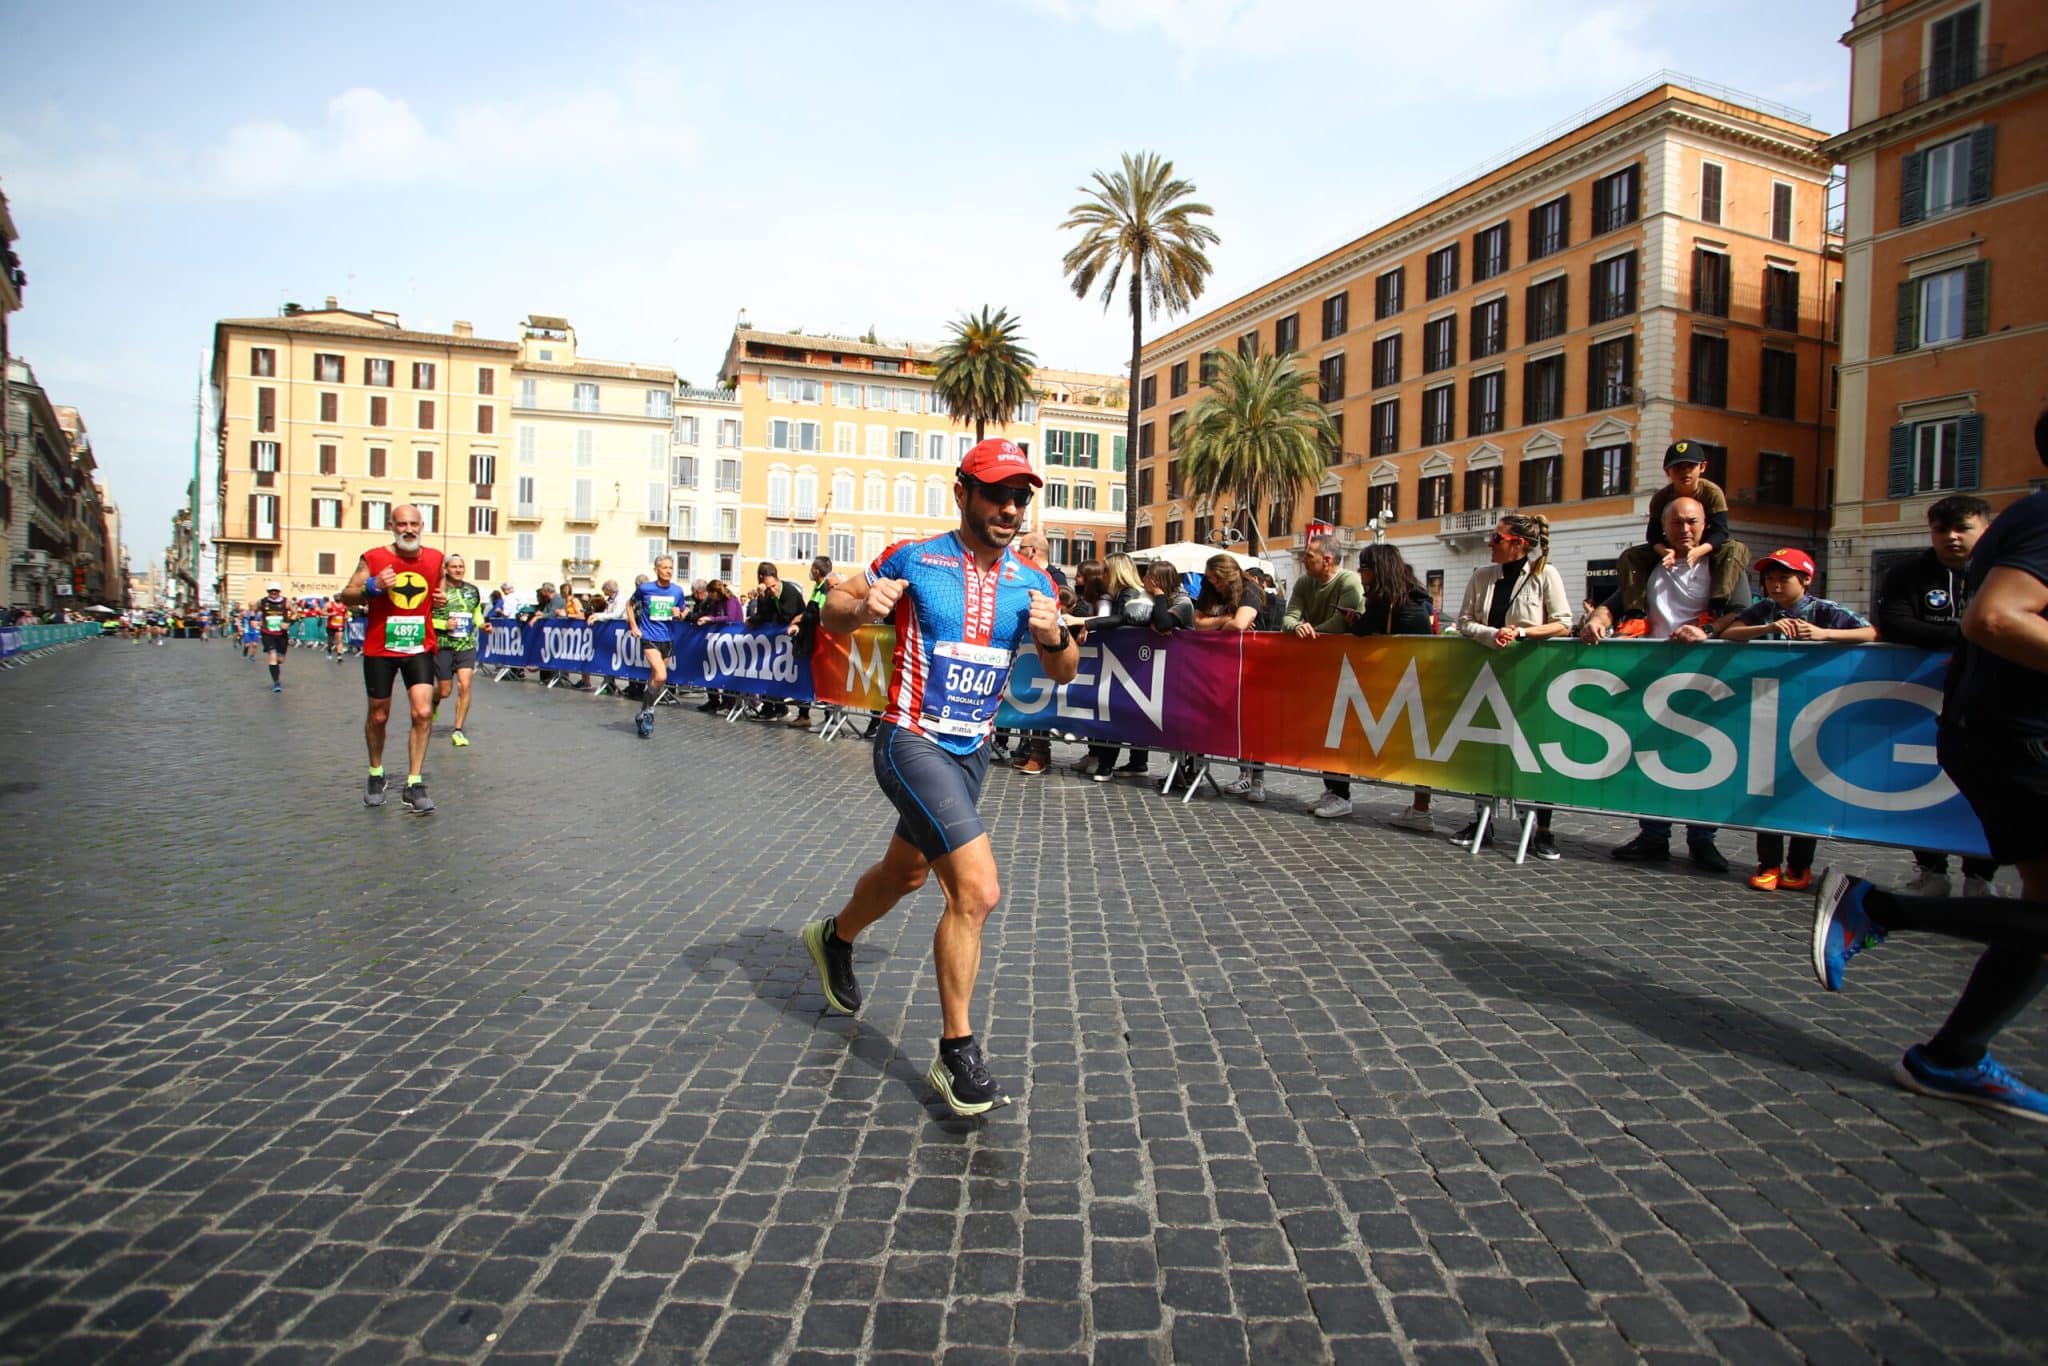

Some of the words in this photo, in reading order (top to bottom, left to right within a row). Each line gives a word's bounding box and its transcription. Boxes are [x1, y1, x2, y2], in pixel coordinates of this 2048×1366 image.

[394, 624, 419, 637] 4892
[541, 626, 595, 664] Joma
[703, 632, 798, 683] Joma
[945, 663, 996, 696] 5840
[941, 705, 951, 718] 8
[971, 709, 983, 721] C
